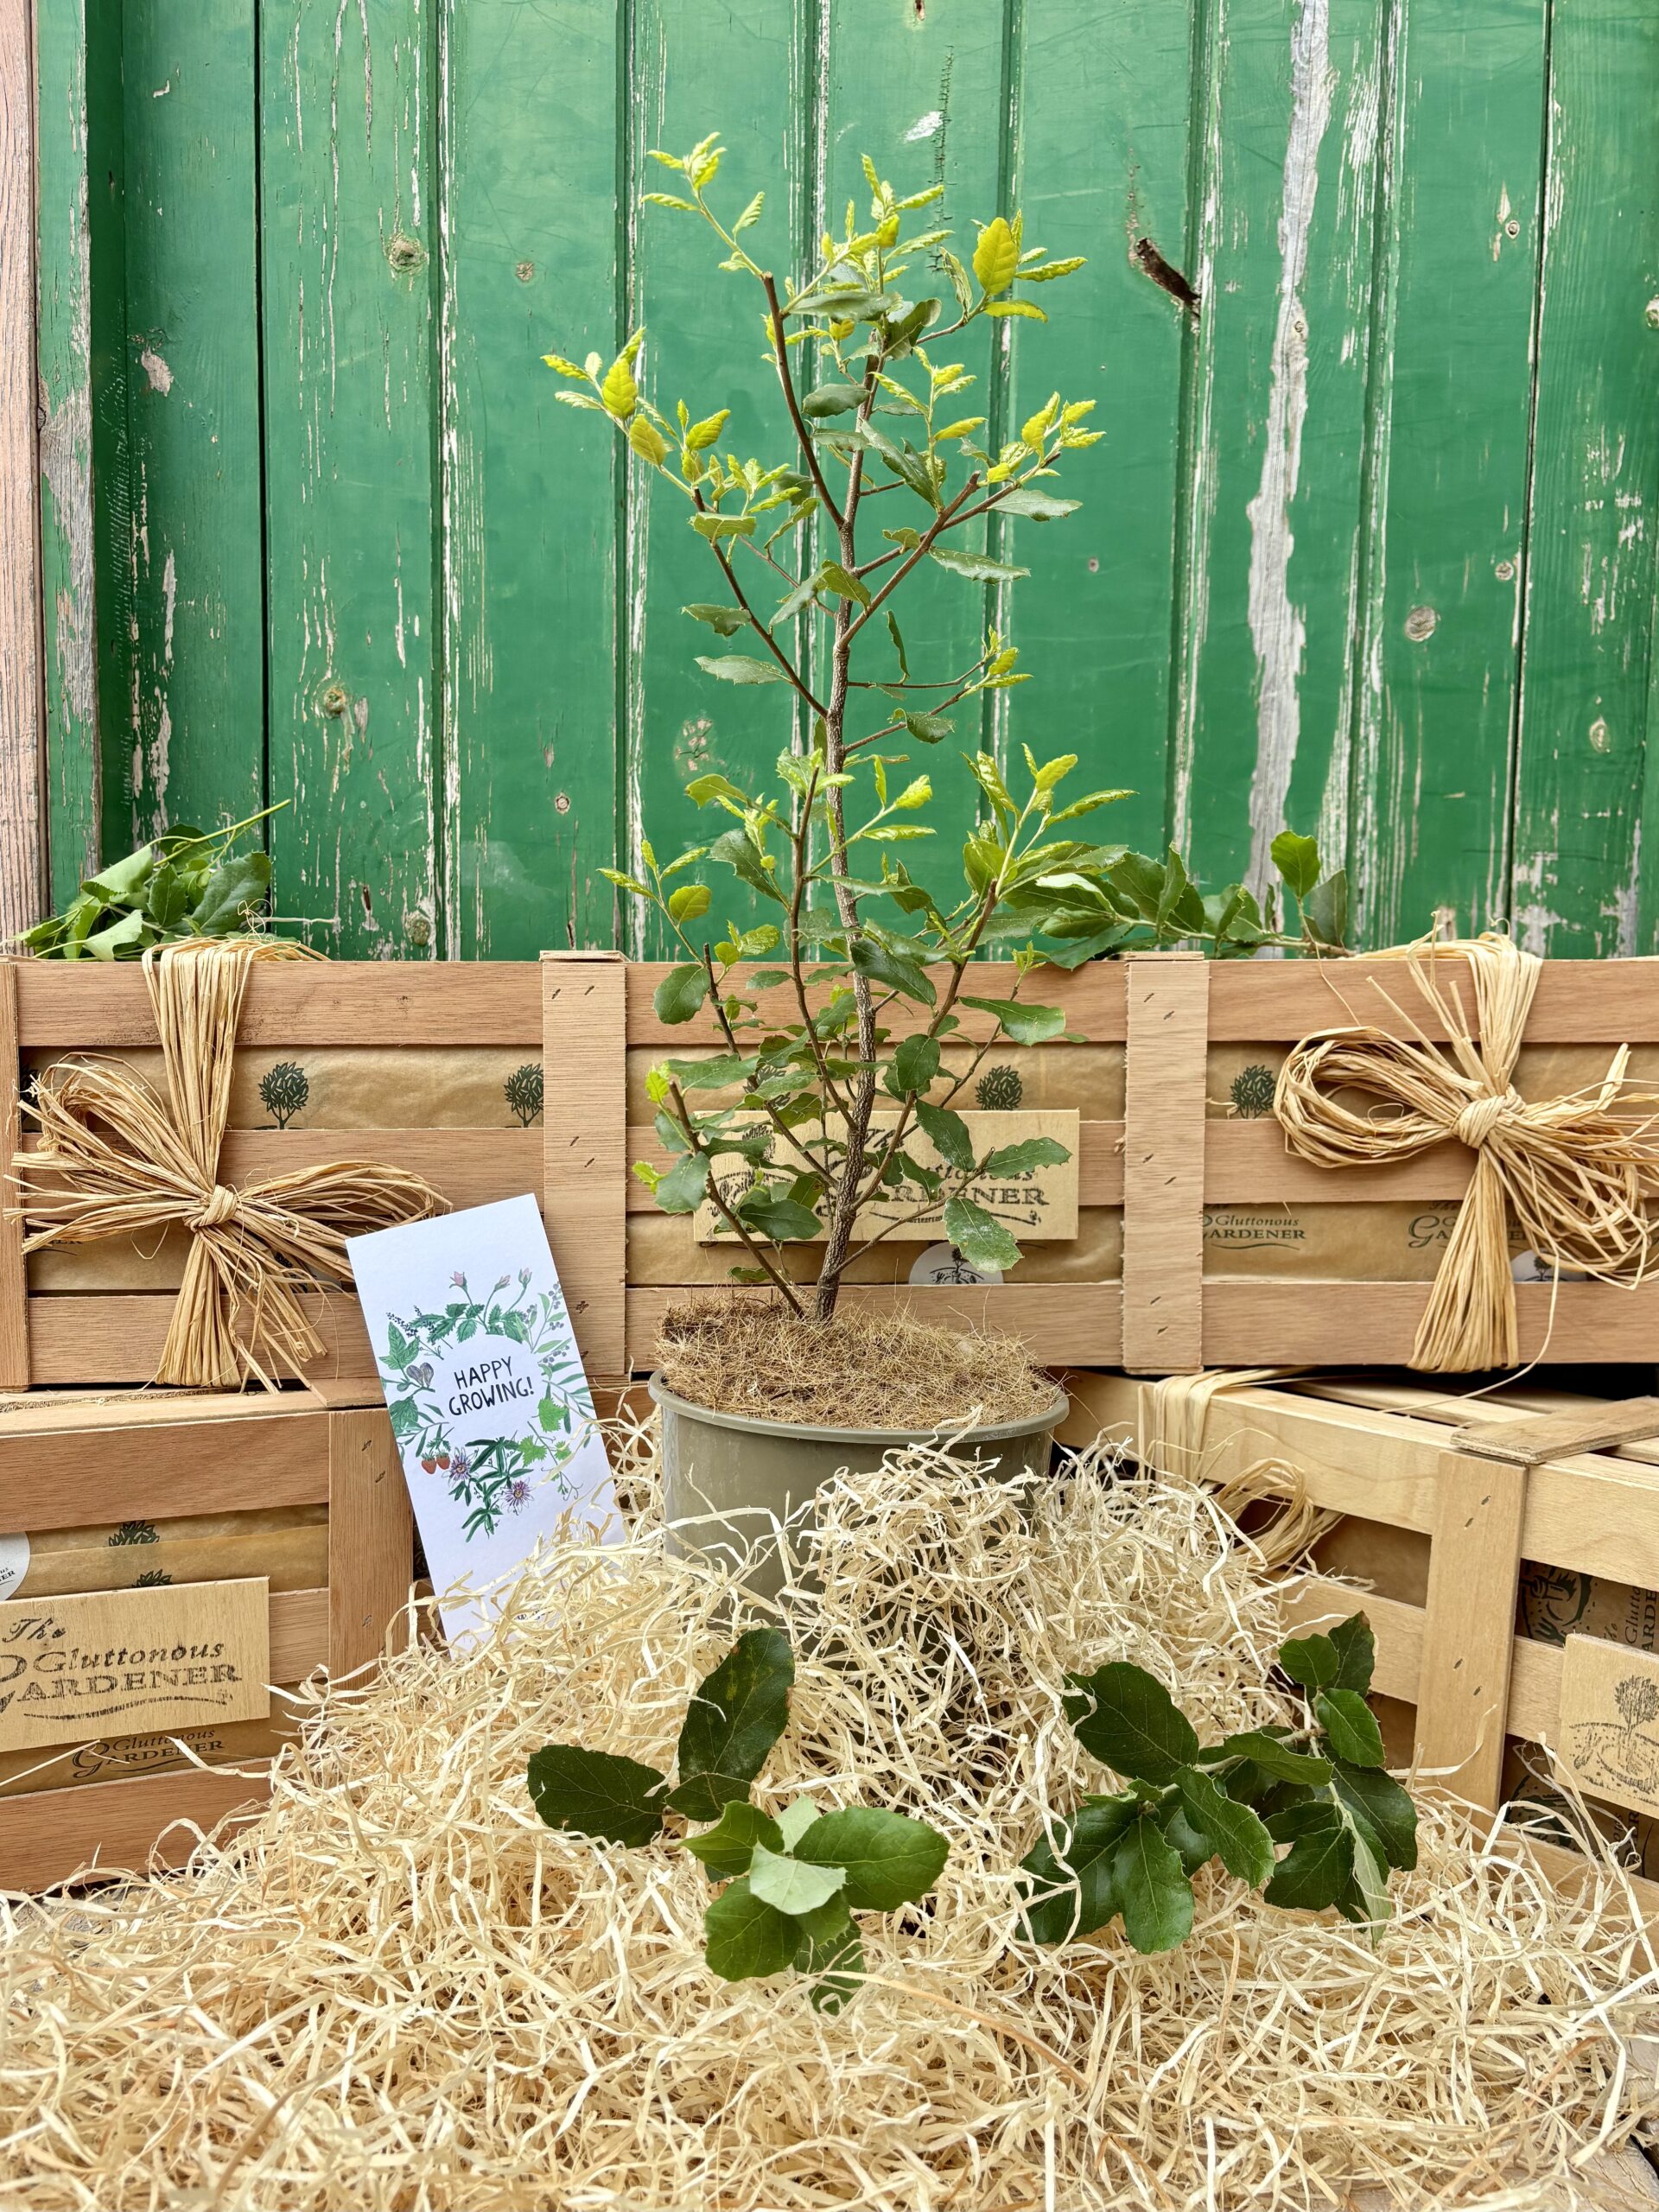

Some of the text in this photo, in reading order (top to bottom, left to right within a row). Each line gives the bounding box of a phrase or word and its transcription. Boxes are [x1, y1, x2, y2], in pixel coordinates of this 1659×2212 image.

[1215, 1214, 1300, 1226] Gluttonous
[454, 1356, 512, 1389] HAPPY
[448, 1376, 534, 1415] GROWING!
[3, 1618, 67, 1643] The
[33, 1643, 225, 1673] Gluttonous
